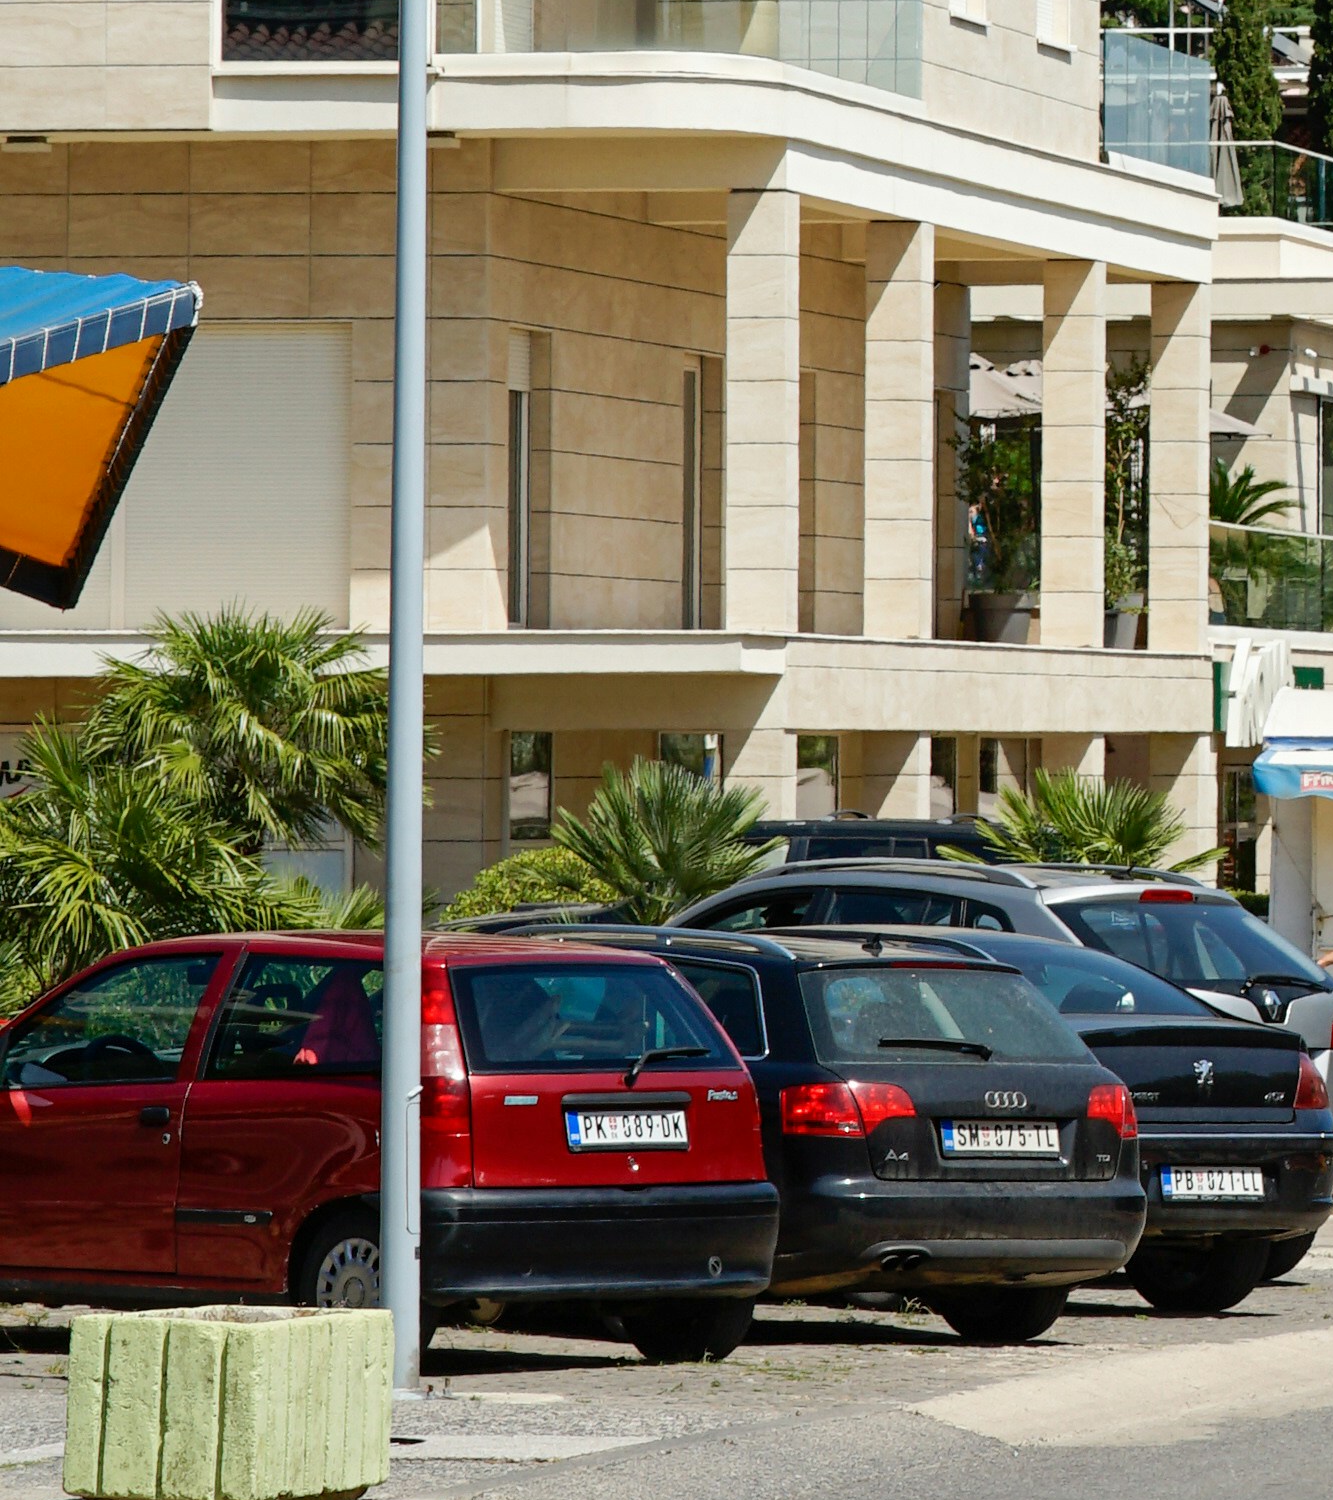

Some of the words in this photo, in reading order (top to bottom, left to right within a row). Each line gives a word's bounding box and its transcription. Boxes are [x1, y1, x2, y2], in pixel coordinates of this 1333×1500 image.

[583, 1114, 607, 1139] PK
[957, 1124, 980, 1147] SM
[884, 1149, 909, 1161] A4
[1174, 1169, 1194, 1191] PB
